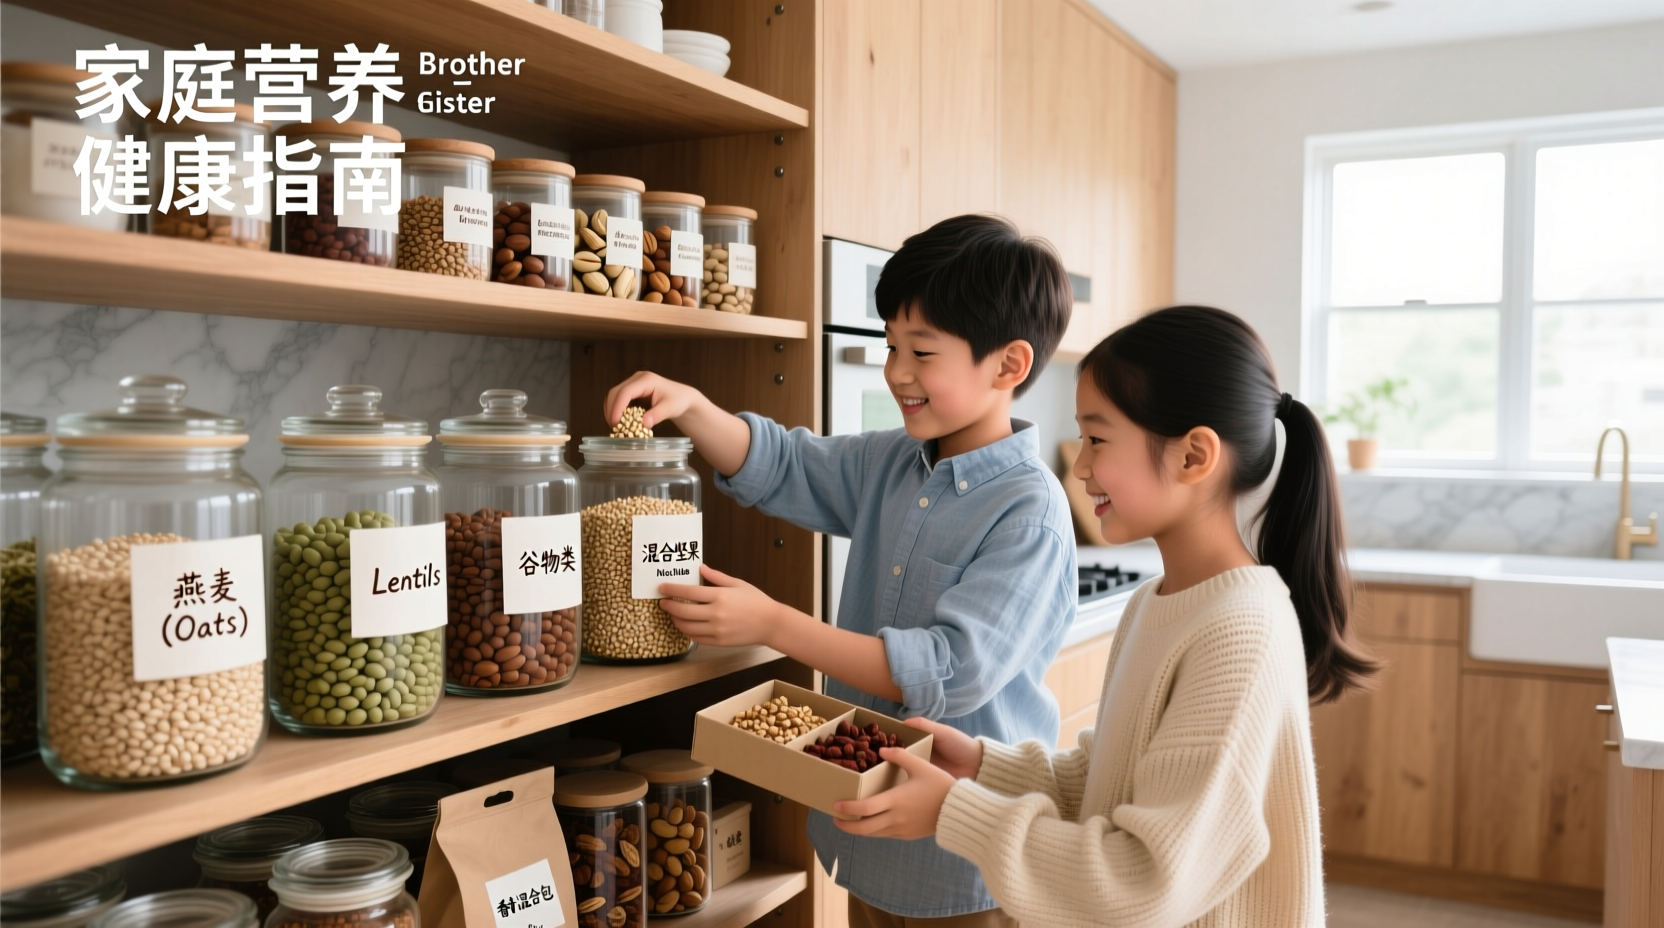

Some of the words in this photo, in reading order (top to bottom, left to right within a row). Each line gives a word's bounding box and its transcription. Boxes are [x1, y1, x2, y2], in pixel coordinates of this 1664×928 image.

[372, 562, 441, 595] Lentils
[518, 545, 576, 576] 谷物类
[173, 567, 238, 609] 燕麦
[162, 606, 248, 648] (Oats)
